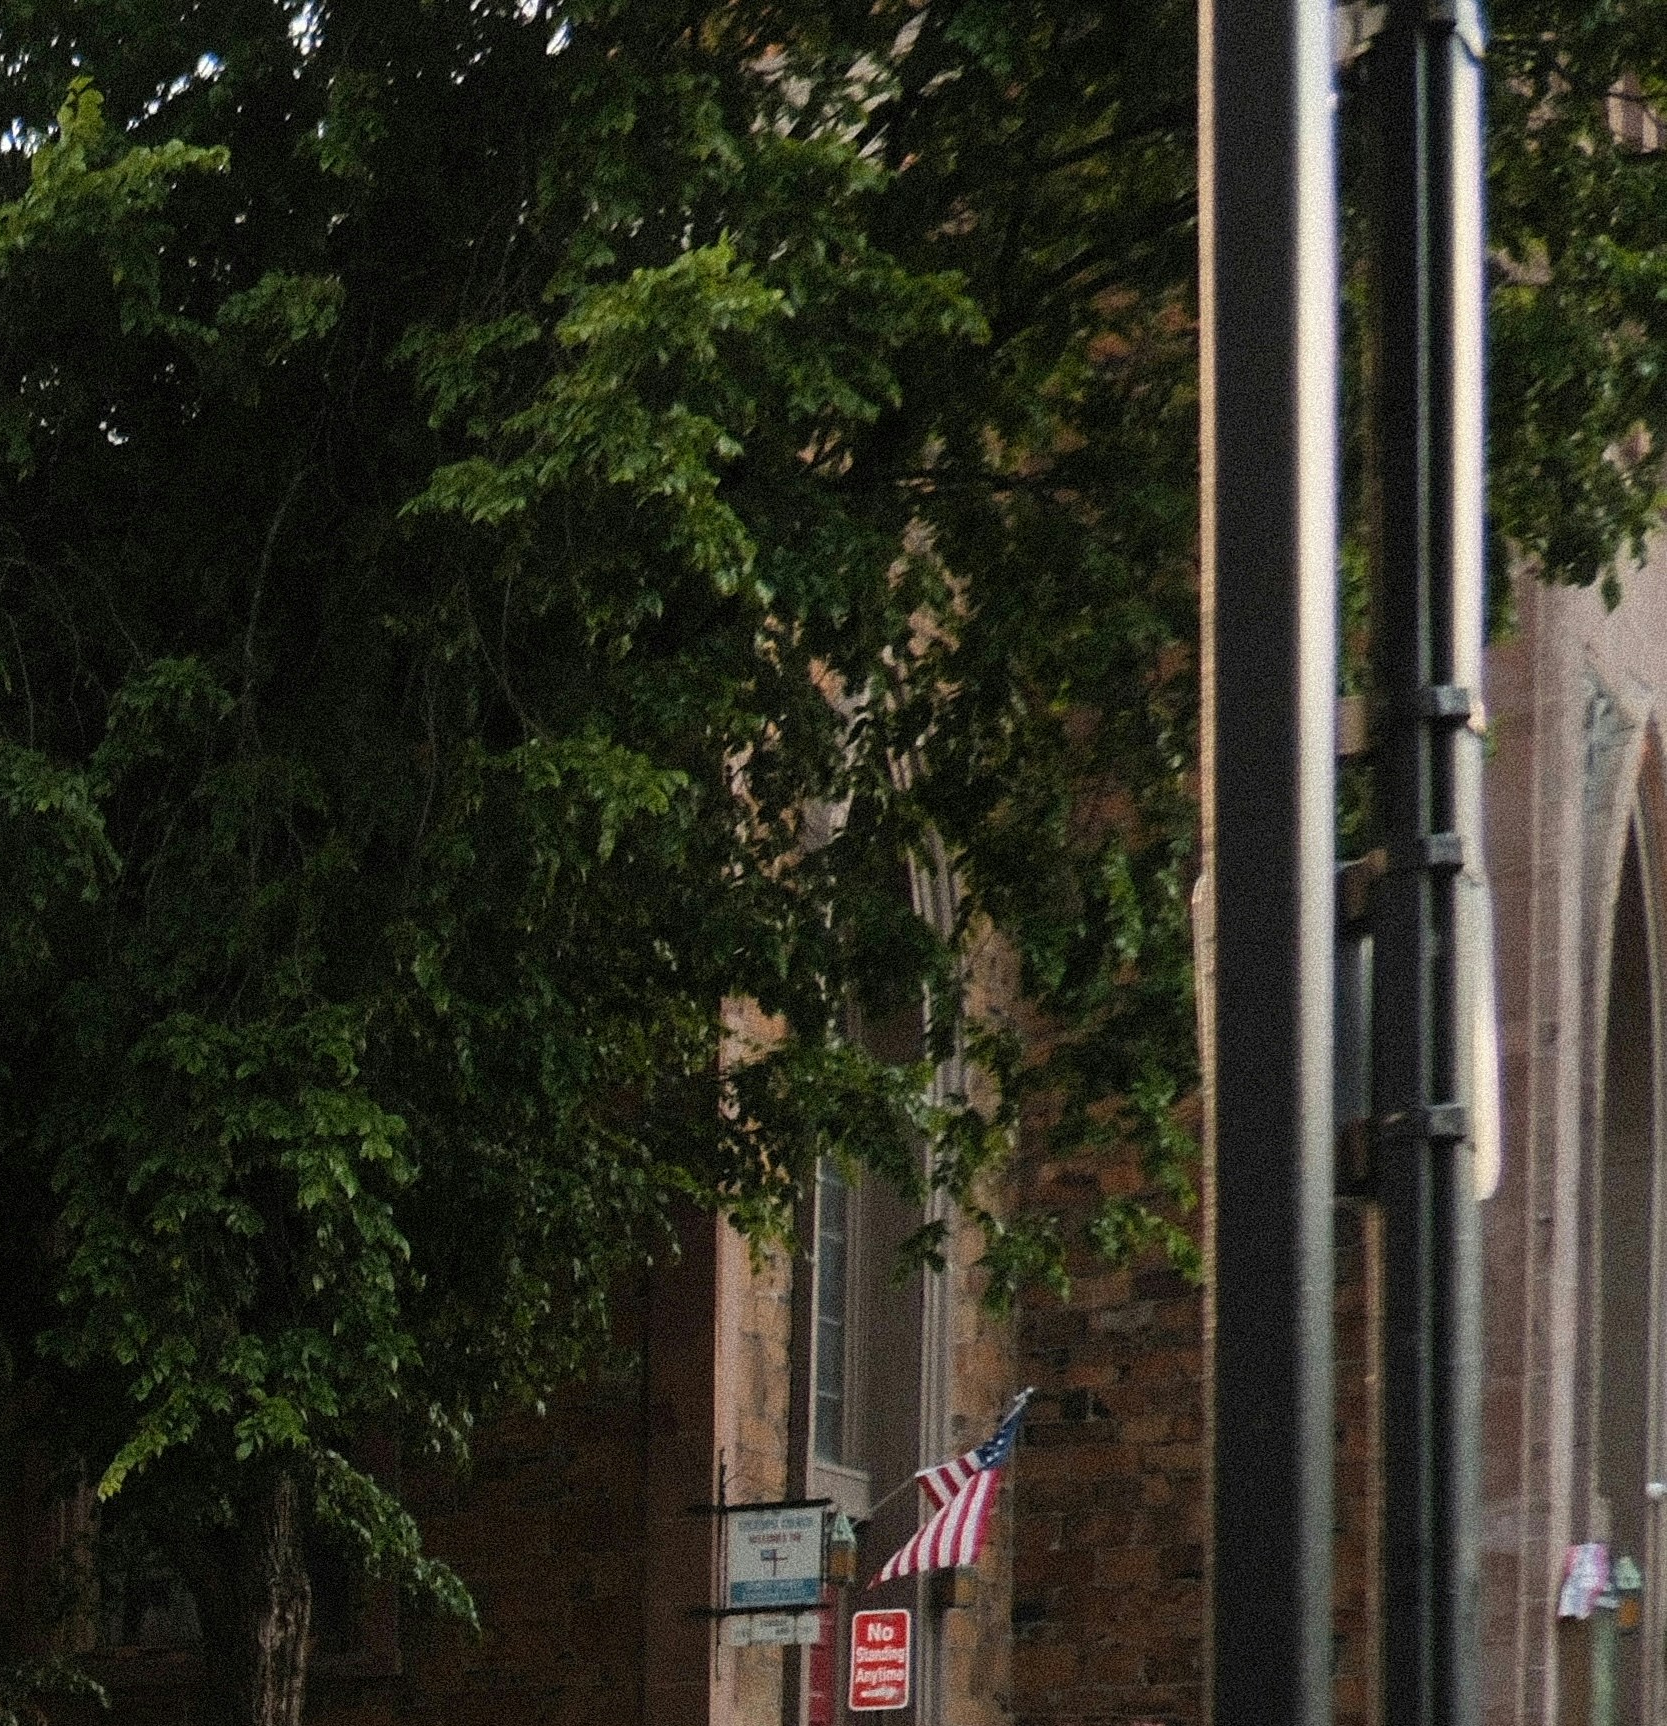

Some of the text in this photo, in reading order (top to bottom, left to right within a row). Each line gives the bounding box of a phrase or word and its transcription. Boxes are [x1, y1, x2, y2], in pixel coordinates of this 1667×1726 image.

[867, 1623, 894, 1642] No
[856, 1646, 905, 1664] Standing
[855, 1667, 905, 1686] Anytime
